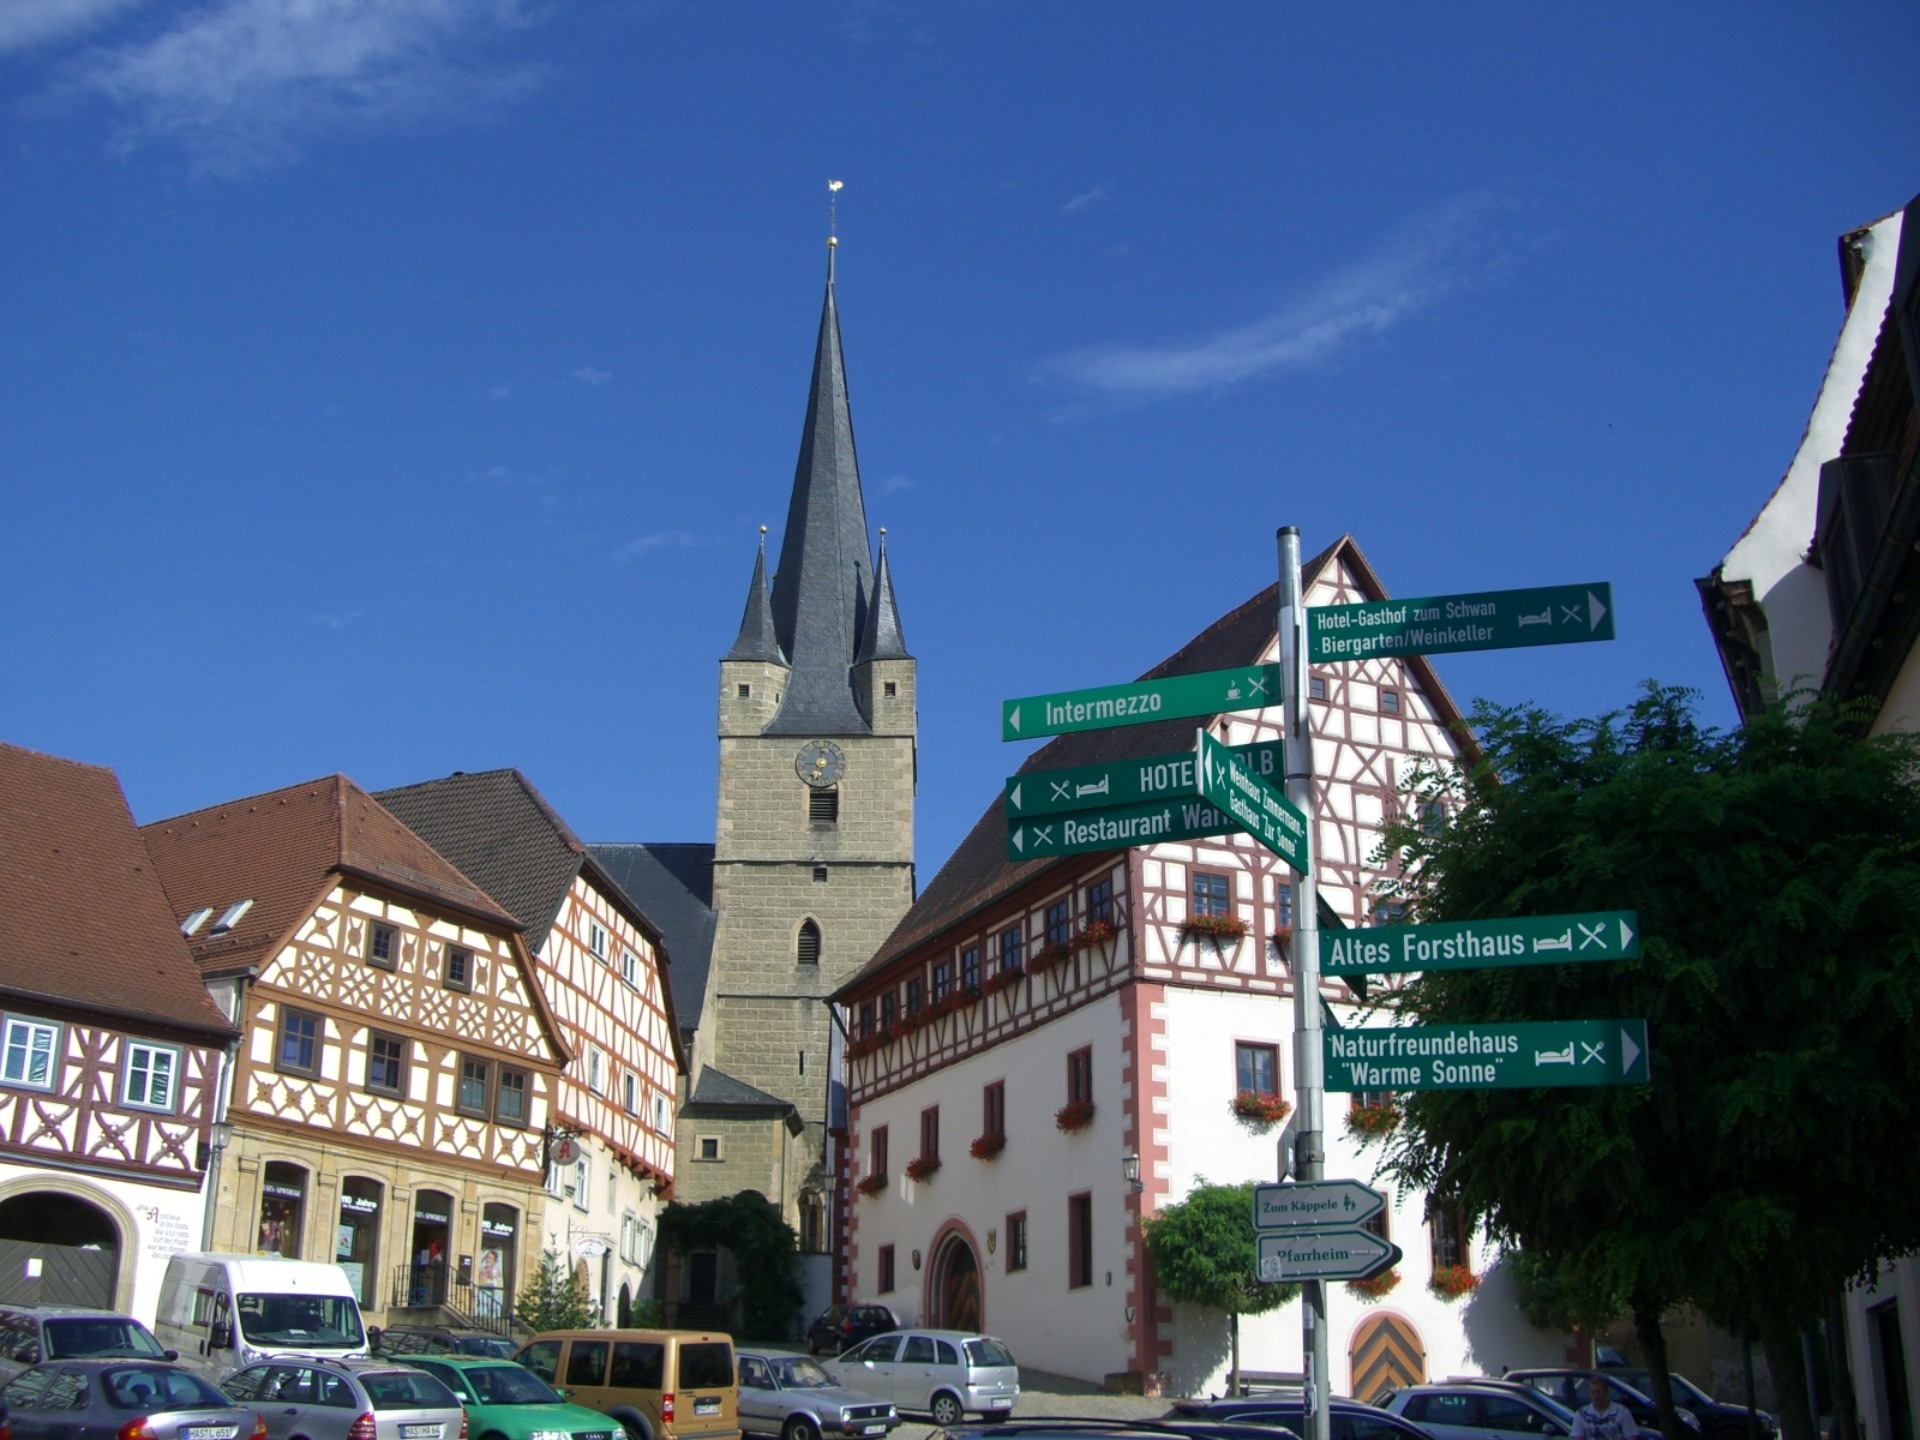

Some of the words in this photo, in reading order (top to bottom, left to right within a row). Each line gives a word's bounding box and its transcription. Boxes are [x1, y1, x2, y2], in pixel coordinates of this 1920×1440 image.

[1317, 605, 1408, 631] Hotel-Gasthof
[1413, 606, 1440, 622] zum
[1446, 600, 1496, 619] Schwan
[1321, 624, 1494, 654] Biergarten/Weinkeller
[1046, 693, 1162, 726] Intermezzo
[1229, 759, 1261, 804] Weinhaus
[1229, 788, 1260, 830] Gasthaus
[1064, 809, 1172, 845] Restaurant
[1331, 938, 1390, 966] Altes
[1403, 930, 1525, 962] Forsthaus
[1331, 1030, 1519, 1058] Naturfreundehaus
[1263, 1202, 1288, 1213] Zum
[1291, 1199, 1338, 1214] Käppele
[1277, 1248, 1349, 1263] Pfarrheim
